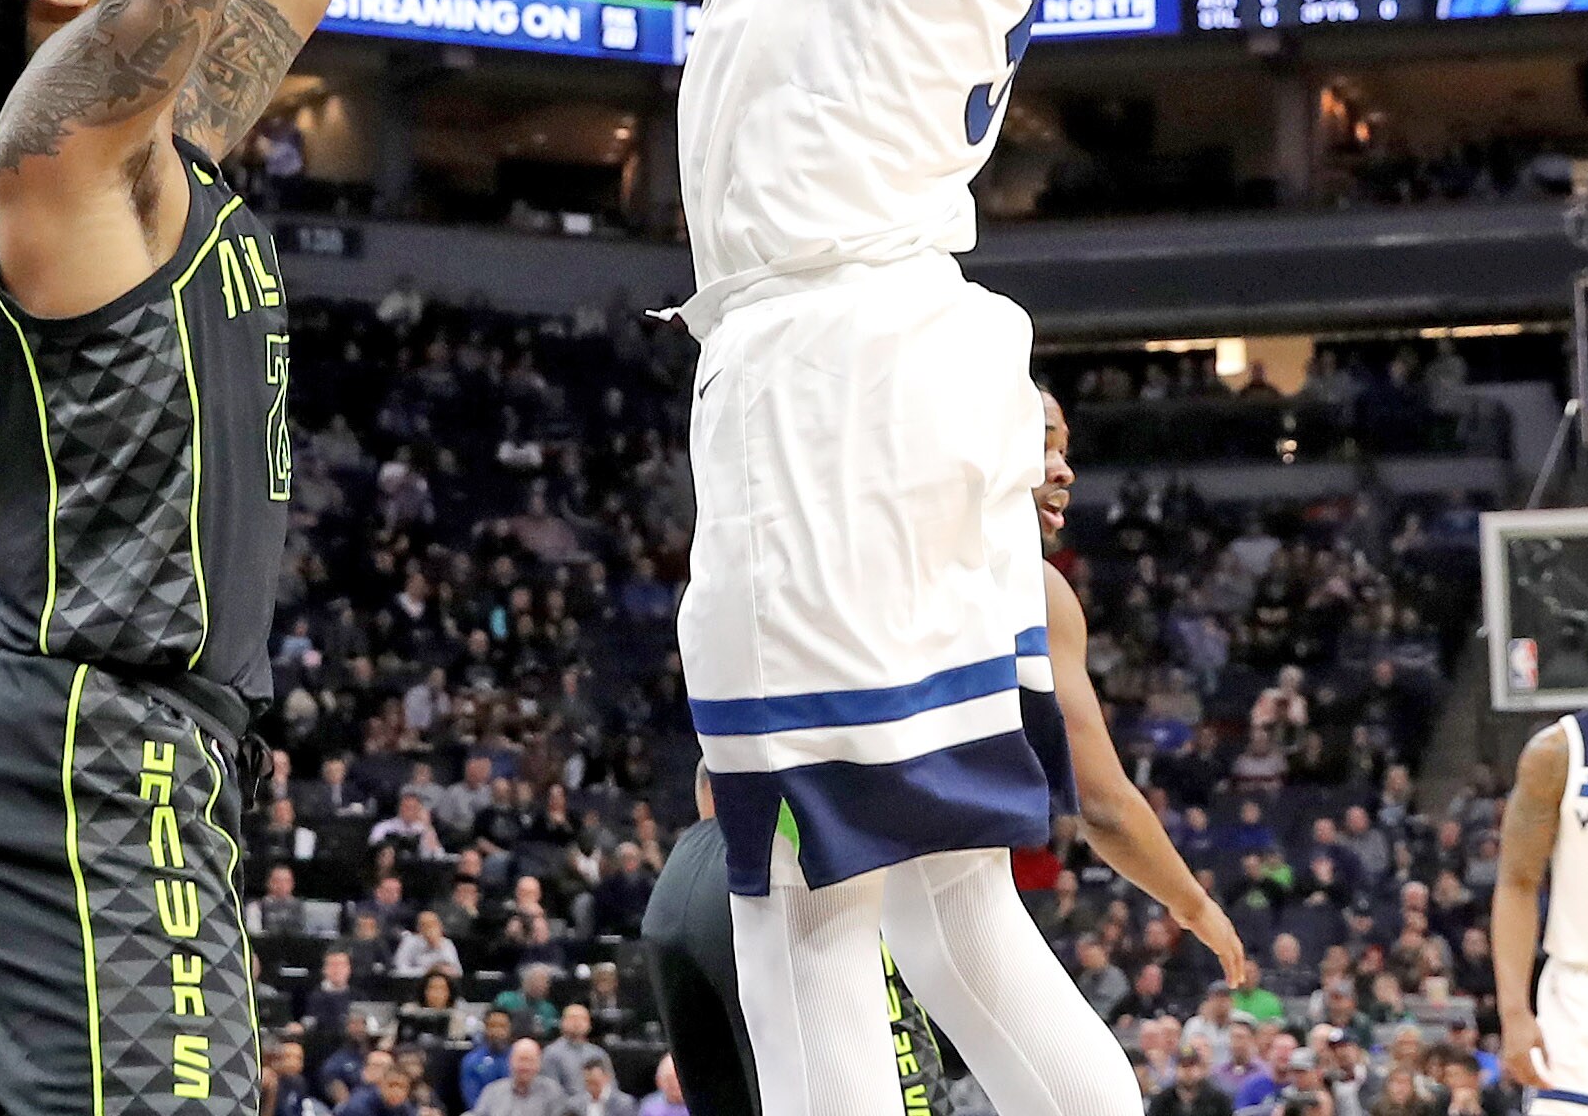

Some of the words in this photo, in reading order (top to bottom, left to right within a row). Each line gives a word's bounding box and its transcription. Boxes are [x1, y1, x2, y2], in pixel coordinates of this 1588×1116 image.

[521, 3, 582, 42] ON
[1260, 6, 1279, 28] 0
[1378, 0, 1398, 20] 0
[139, 739, 212, 1100] HAWKS
